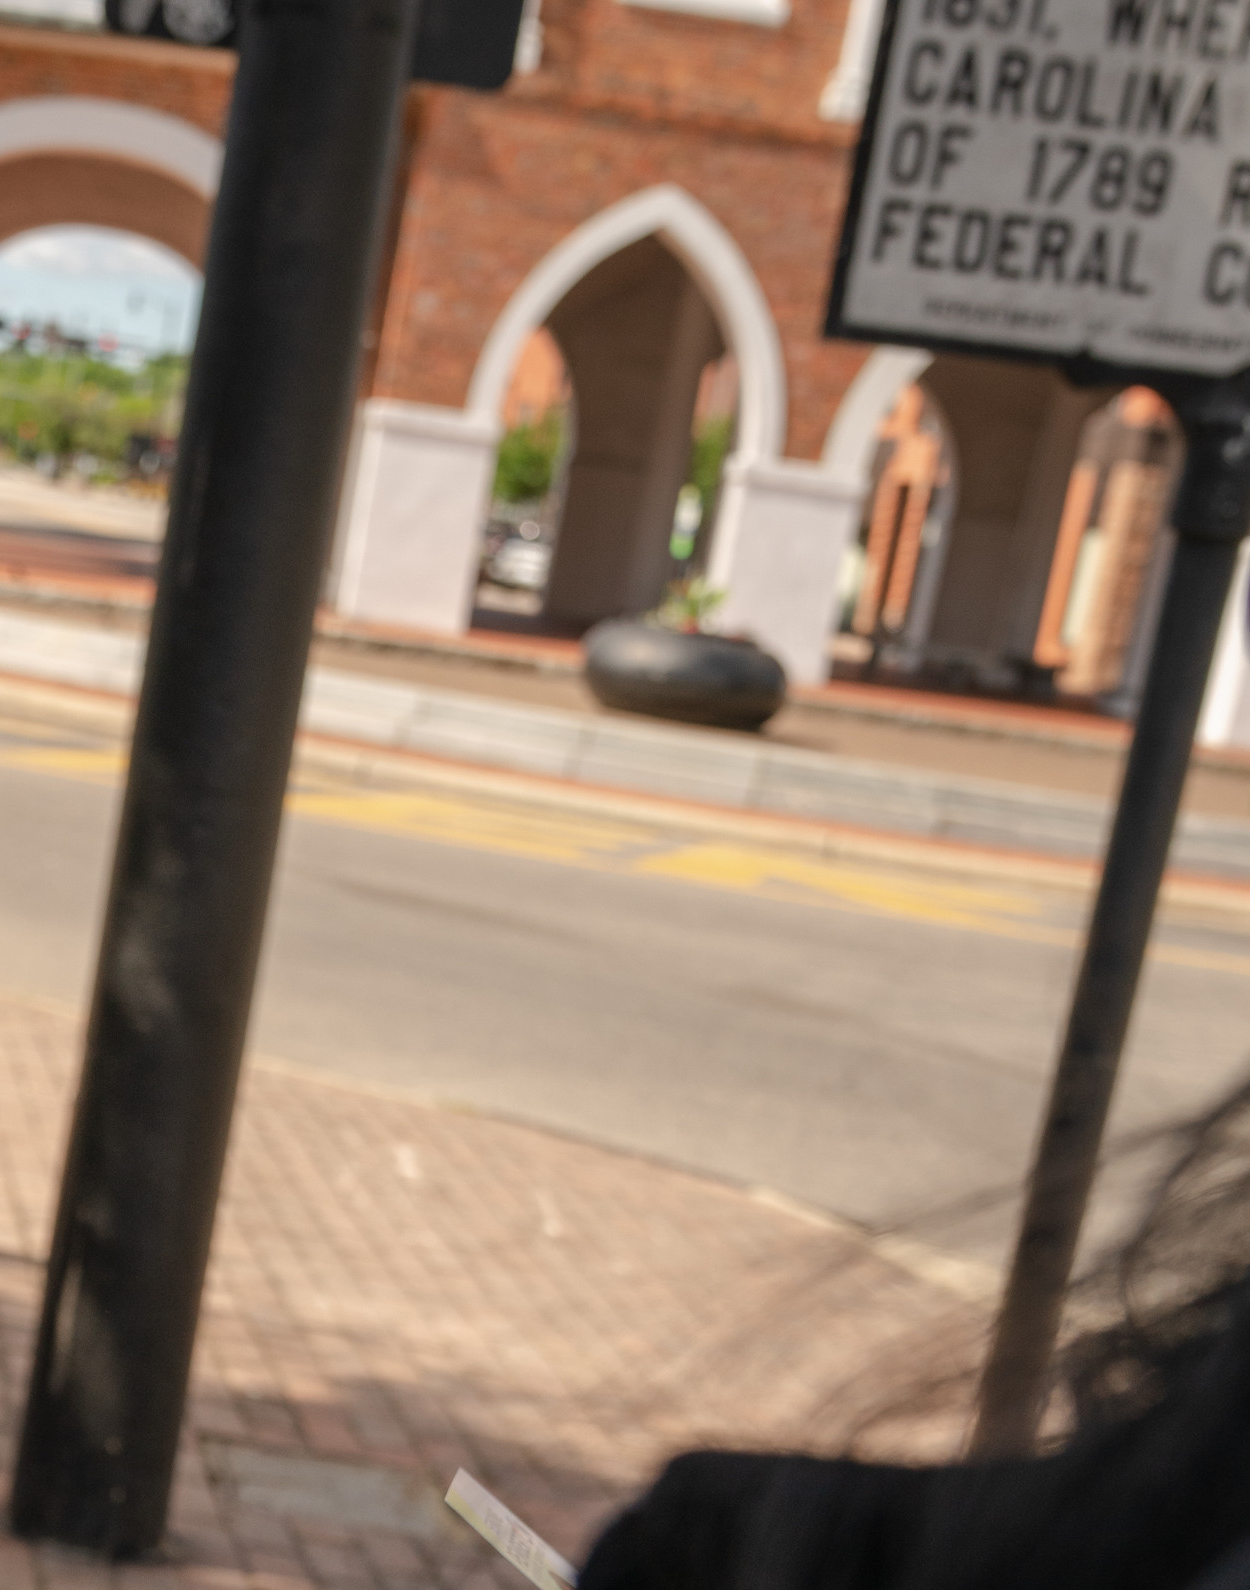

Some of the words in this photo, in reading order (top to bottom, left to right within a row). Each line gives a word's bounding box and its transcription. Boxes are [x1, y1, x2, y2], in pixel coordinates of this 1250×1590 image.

[1107, 0, 1250, 62] WHE
[902, 36, 1220, 142] CAROLINA
[888, 117, 973, 191] OF
[1026, 134, 1174, 218] 1789
[871, 197, 1151, 297] FEDERAL
[1203, 240, 1250, 310] C
